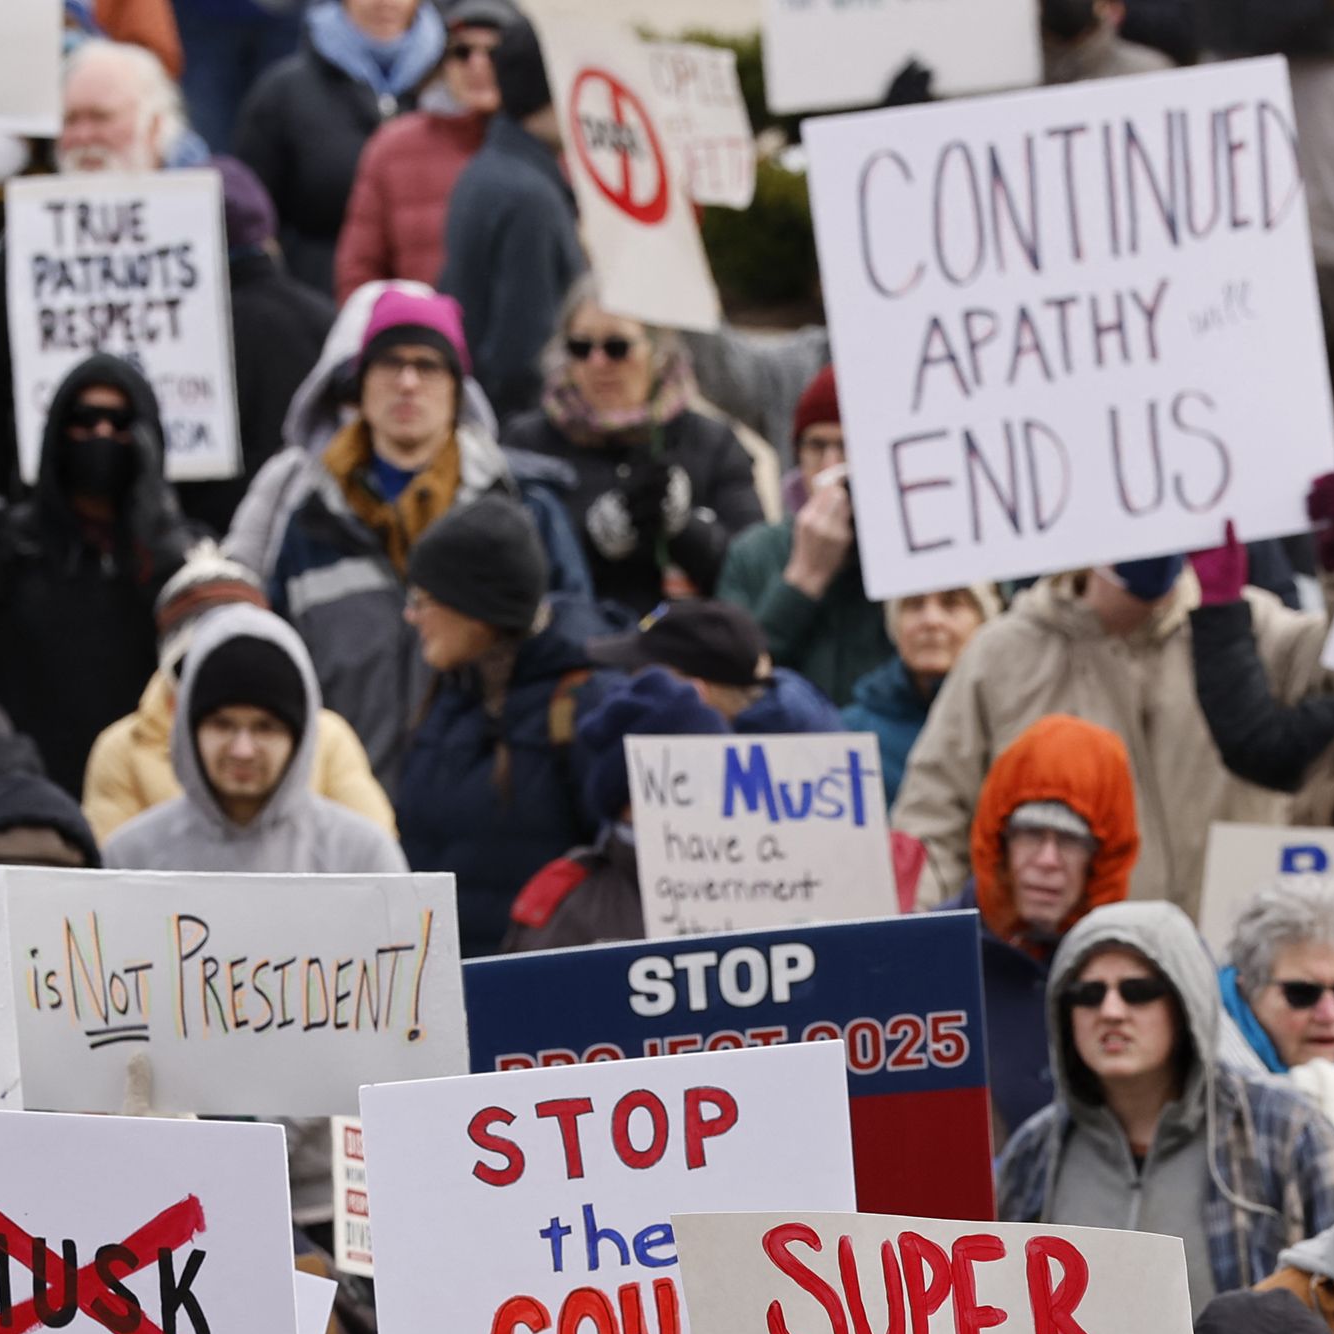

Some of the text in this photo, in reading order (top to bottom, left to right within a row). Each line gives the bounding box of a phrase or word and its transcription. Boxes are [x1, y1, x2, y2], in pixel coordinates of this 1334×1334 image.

[46, 201, 147, 246] TRUE
[858, 101, 1305, 298] CONTINUED
[33, 245, 199, 293] PATRIOTS
[39, 300, 182, 353] RESPECT
[912, 277, 1169, 413] APATHY
[890, 390, 1232, 556] END US
[630, 744, 878, 827] We Must
[664, 817, 785, 862] have a
[655, 873, 822, 923] government
[627, 943, 817, 1017] STOP
[467, 1086, 739, 1188] STOP
[539, 1203, 678, 1273] the
